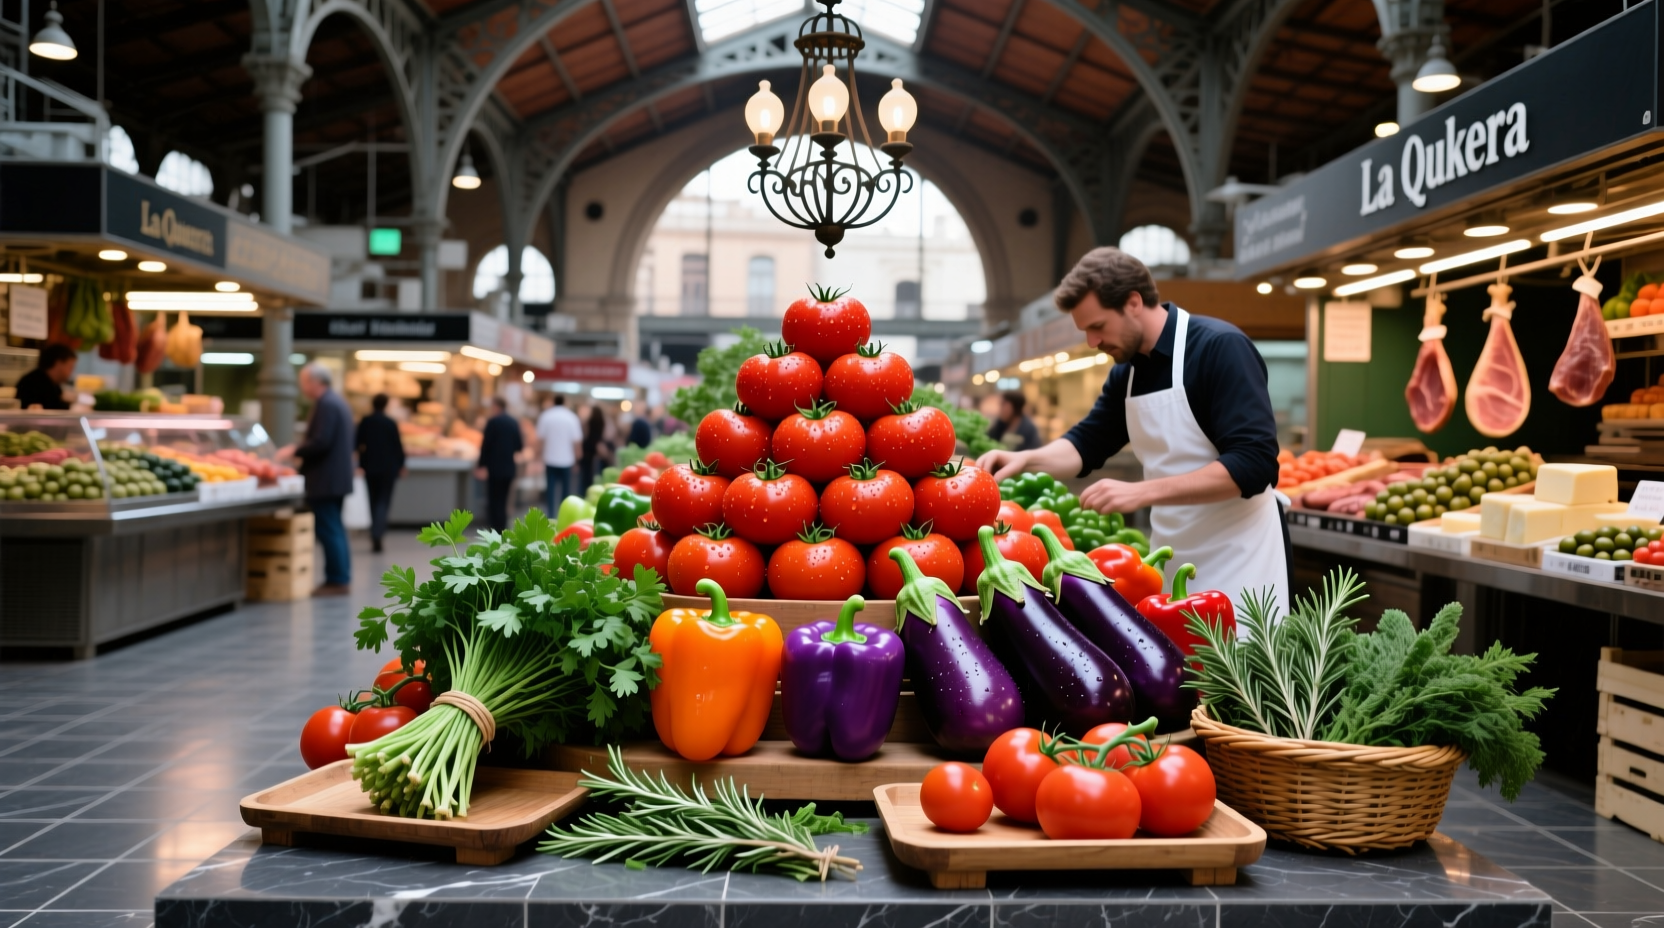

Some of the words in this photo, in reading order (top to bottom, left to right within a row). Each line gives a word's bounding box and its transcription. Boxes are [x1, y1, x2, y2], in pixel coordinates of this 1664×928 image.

[1360, 158, 1395, 216] La
[1401, 102, 1530, 207] Qukera
[140, 199, 162, 239] La
